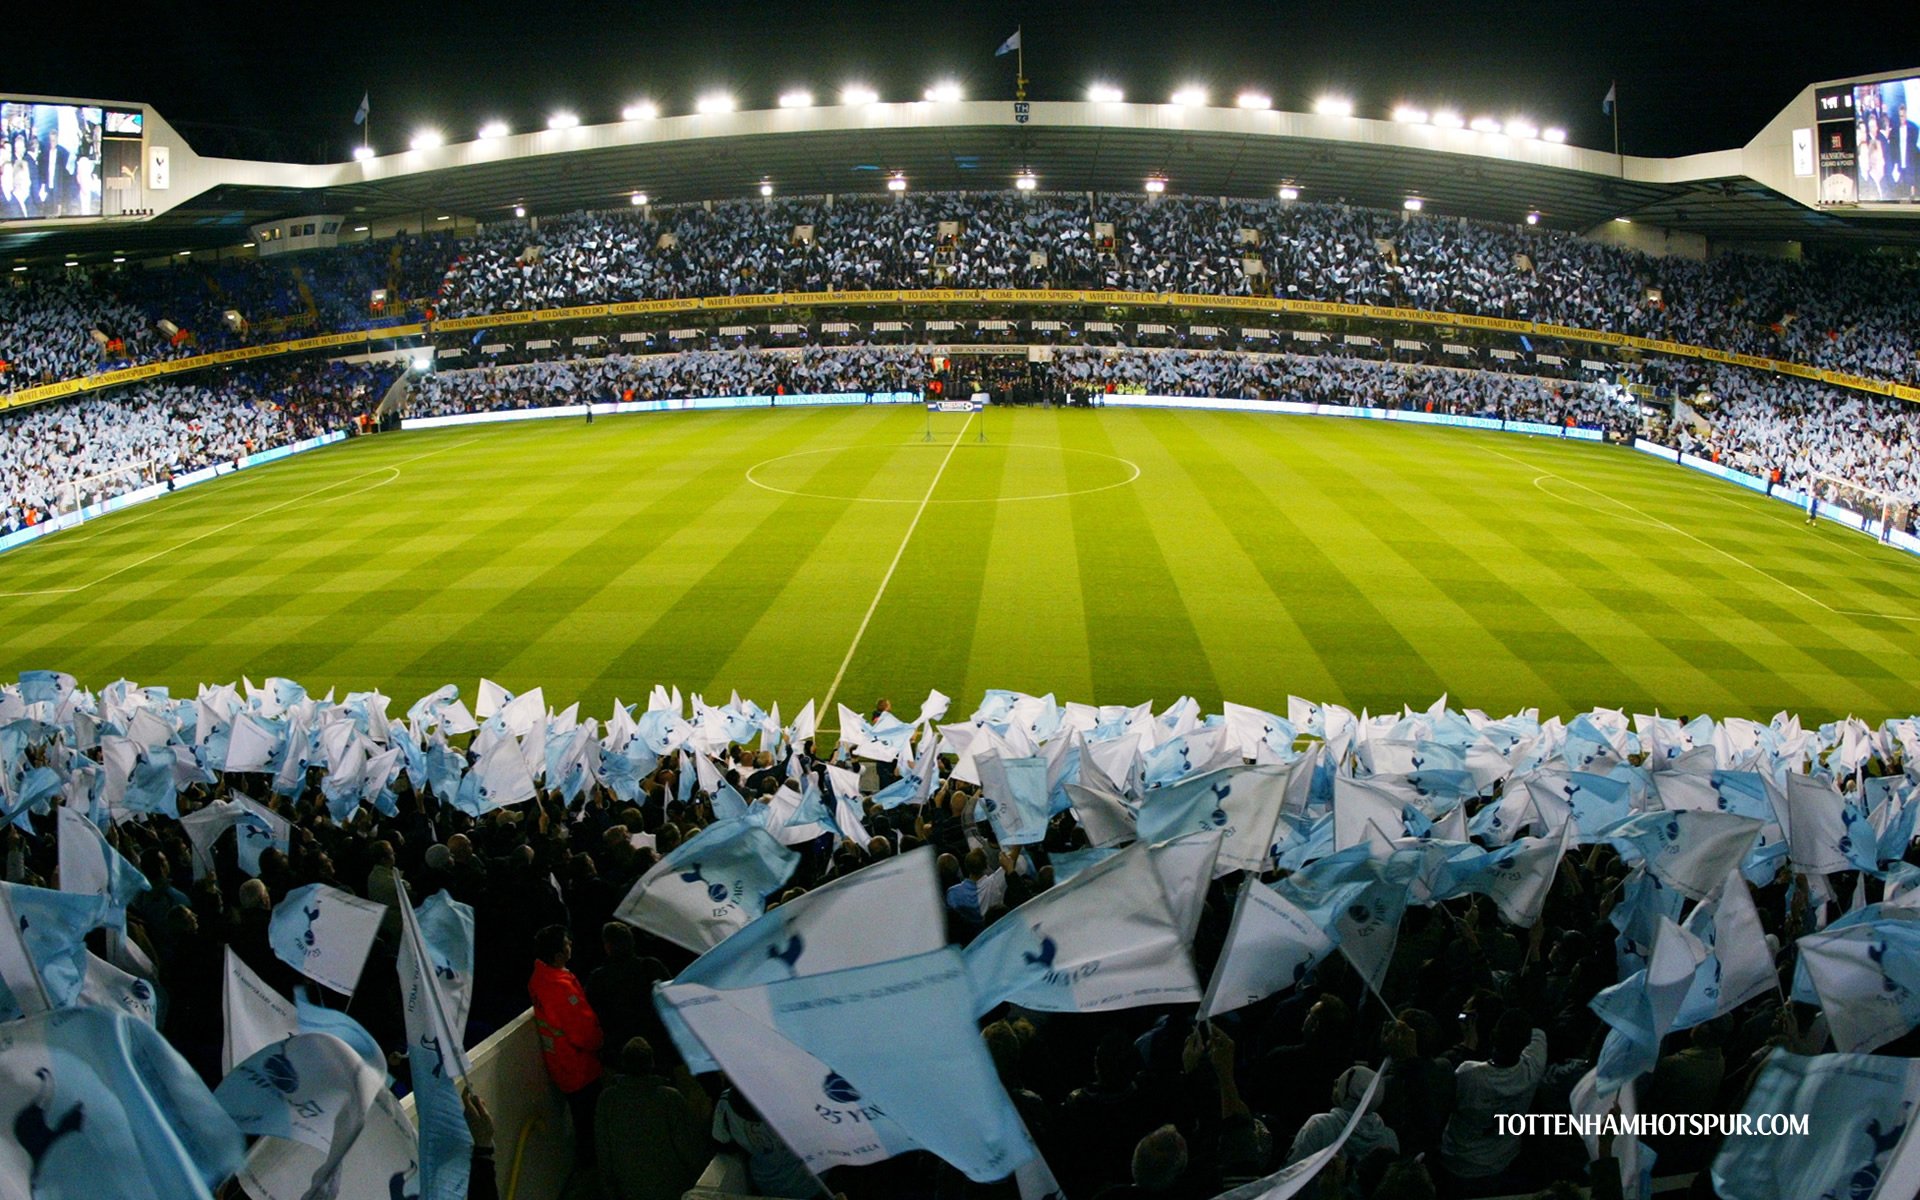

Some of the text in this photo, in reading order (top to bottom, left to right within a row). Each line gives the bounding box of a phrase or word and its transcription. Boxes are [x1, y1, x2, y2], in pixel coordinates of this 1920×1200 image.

[1015, 104, 1029, 112] TH
[908, 291, 919, 299] TO
[920, 291, 940, 299] DARE
[943, 291, 951, 299] IS
[991, 291, 1074, 300] COME ON YOU SPURS
[1089, 292, 1114, 300] WHITE
[1116, 292, 1139, 301] HART
[616, 299, 693, 312] COME ON YOU SPURS
[707, 295, 777, 306] WHITE HART LANE
[542, 311, 551, 319] TO
[552, 309, 571, 317] DARE
[582, 307, 591, 315] TO
[592, 306, 604, 314] DO
[1292, 302, 1303, 310] TO
[1304, 303, 1324, 311] DARE
[1336, 305, 1346, 313] TO
[1347, 306, 1359, 314] DO
[1372, 308, 1449, 322] COME ON YOU SPURS
[821, 323, 849, 333] PUMA
[873, 322, 902, 331] PUMA
[926, 321, 954, 330] PUMA
[979, 321, 1008, 330] PUMA
[1032, 321, 1060, 330] PUMA
[1085, 322, 1113, 331] PUMA
[1462, 316, 1528, 330] WHITE HART LANE
[719, 326, 747, 336] PUMA
[770, 324, 797, 334] PUMA
[1137, 324, 1166, 333] PUMA
[1190, 326, 1218, 335] PUMA
[1242, 328, 1269, 338] PUMA
[620, 332, 646, 342] PUMA
[669, 329, 696, 339] PUMA
[1293, 331, 1320, 341] PUMA
[572, 336, 598, 346] PUMA
[1344, 335, 1371, 346] PUMA
[1394, 339, 1420, 350] PUMA
[1443, 344, 1468, 354] PUMA
